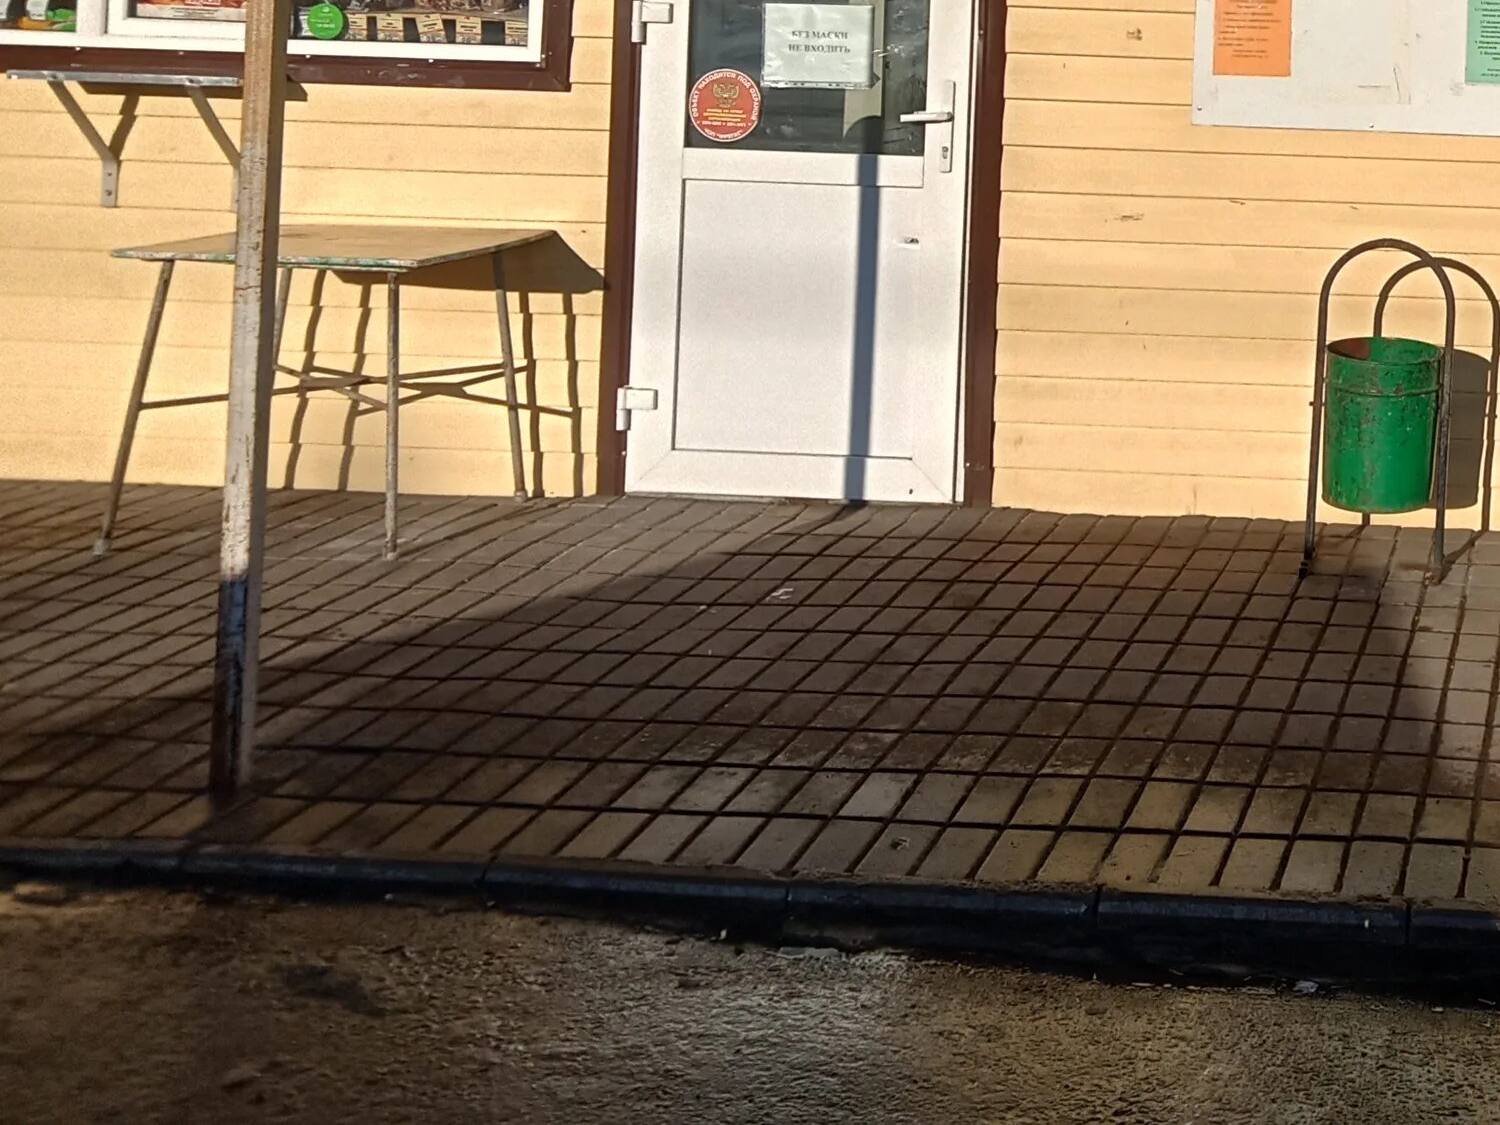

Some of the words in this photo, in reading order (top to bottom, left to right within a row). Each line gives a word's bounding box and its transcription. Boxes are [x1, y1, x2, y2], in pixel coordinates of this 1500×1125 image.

[792, 31, 810, 39] БЕЗ
[812, 31, 848, 40] МАСКИ
[788, 44, 803, 52] НЕ
[804, 44, 851, 54] ВХОДИТЬ
